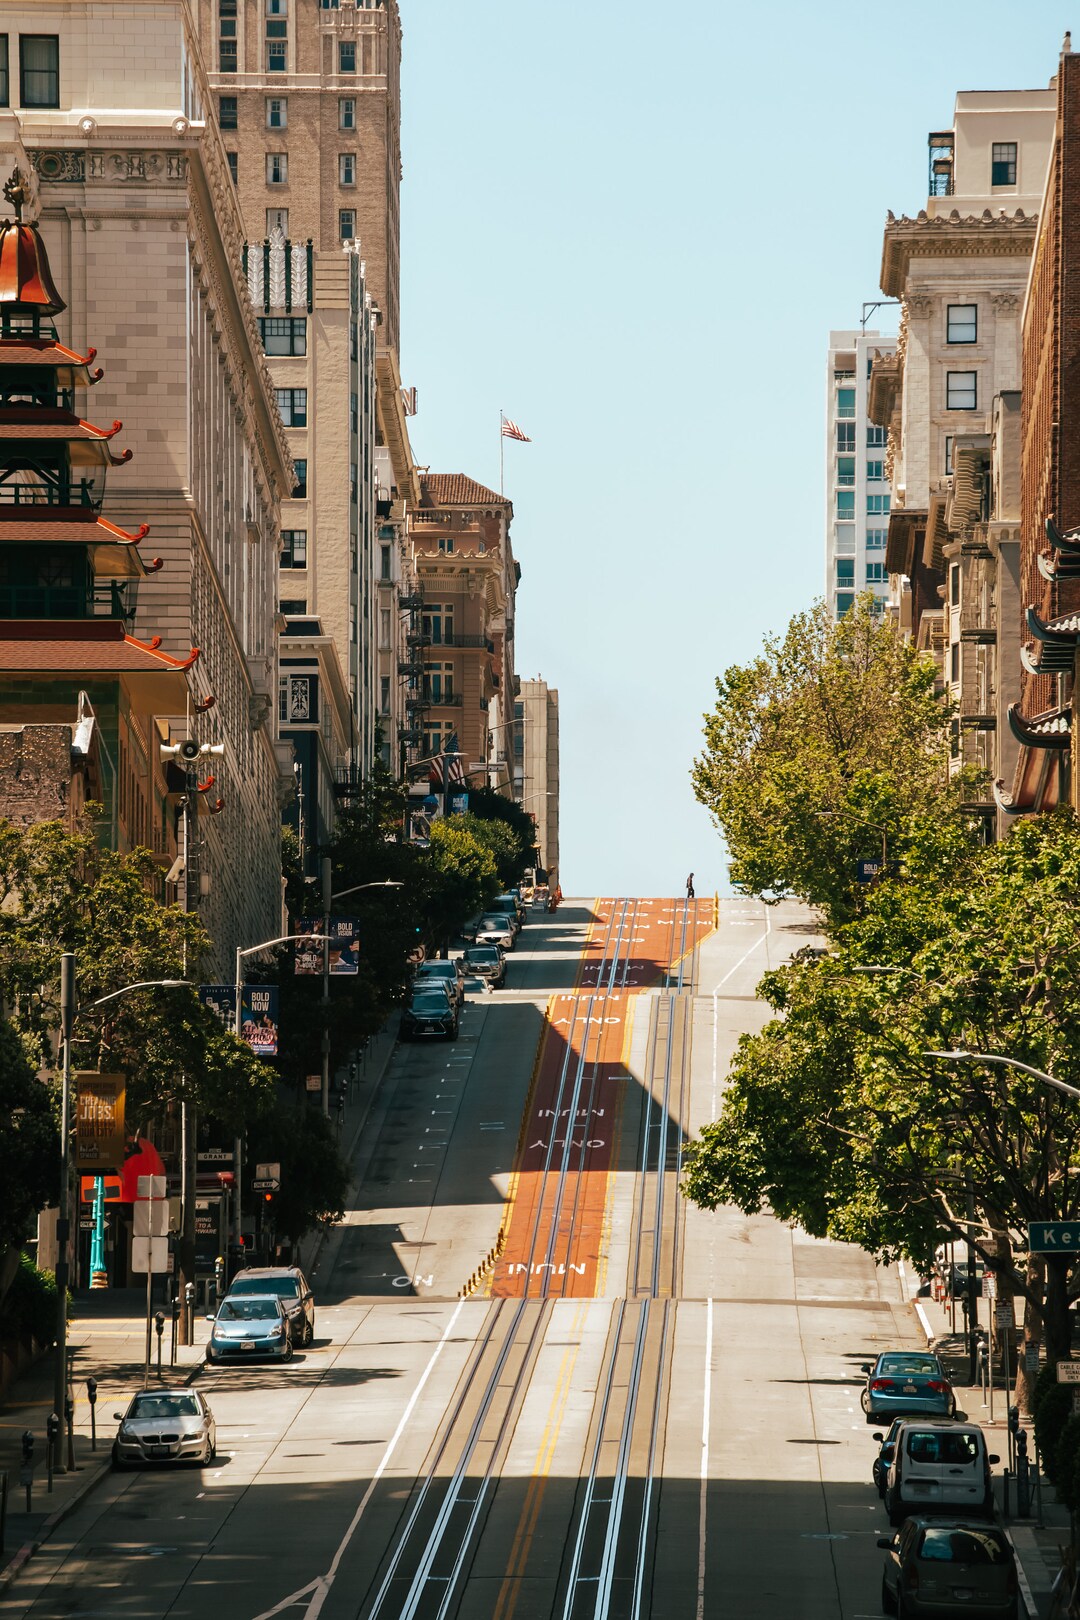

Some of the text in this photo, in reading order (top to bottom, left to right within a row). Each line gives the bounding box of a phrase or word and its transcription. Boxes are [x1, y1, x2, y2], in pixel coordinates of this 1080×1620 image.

[337, 922, 353, 931] BOLD
[251, 992, 270, 1002] BOLD
[251, 1001, 270, 1012] NOW
[554, 1017, 621, 1025] ONLY
[80, 1095, 116, 1106] CREATING
[80, 1105, 115, 1120] JOBS.
[538, 1108, 605, 1118] MUNI
[529, 1139, 605, 1149] ONLY
[1043, 1229, 1080, 1244] Ke
[508, 1262, 586, 1275] MUNI
[391, 1274, 433, 1288] NO
